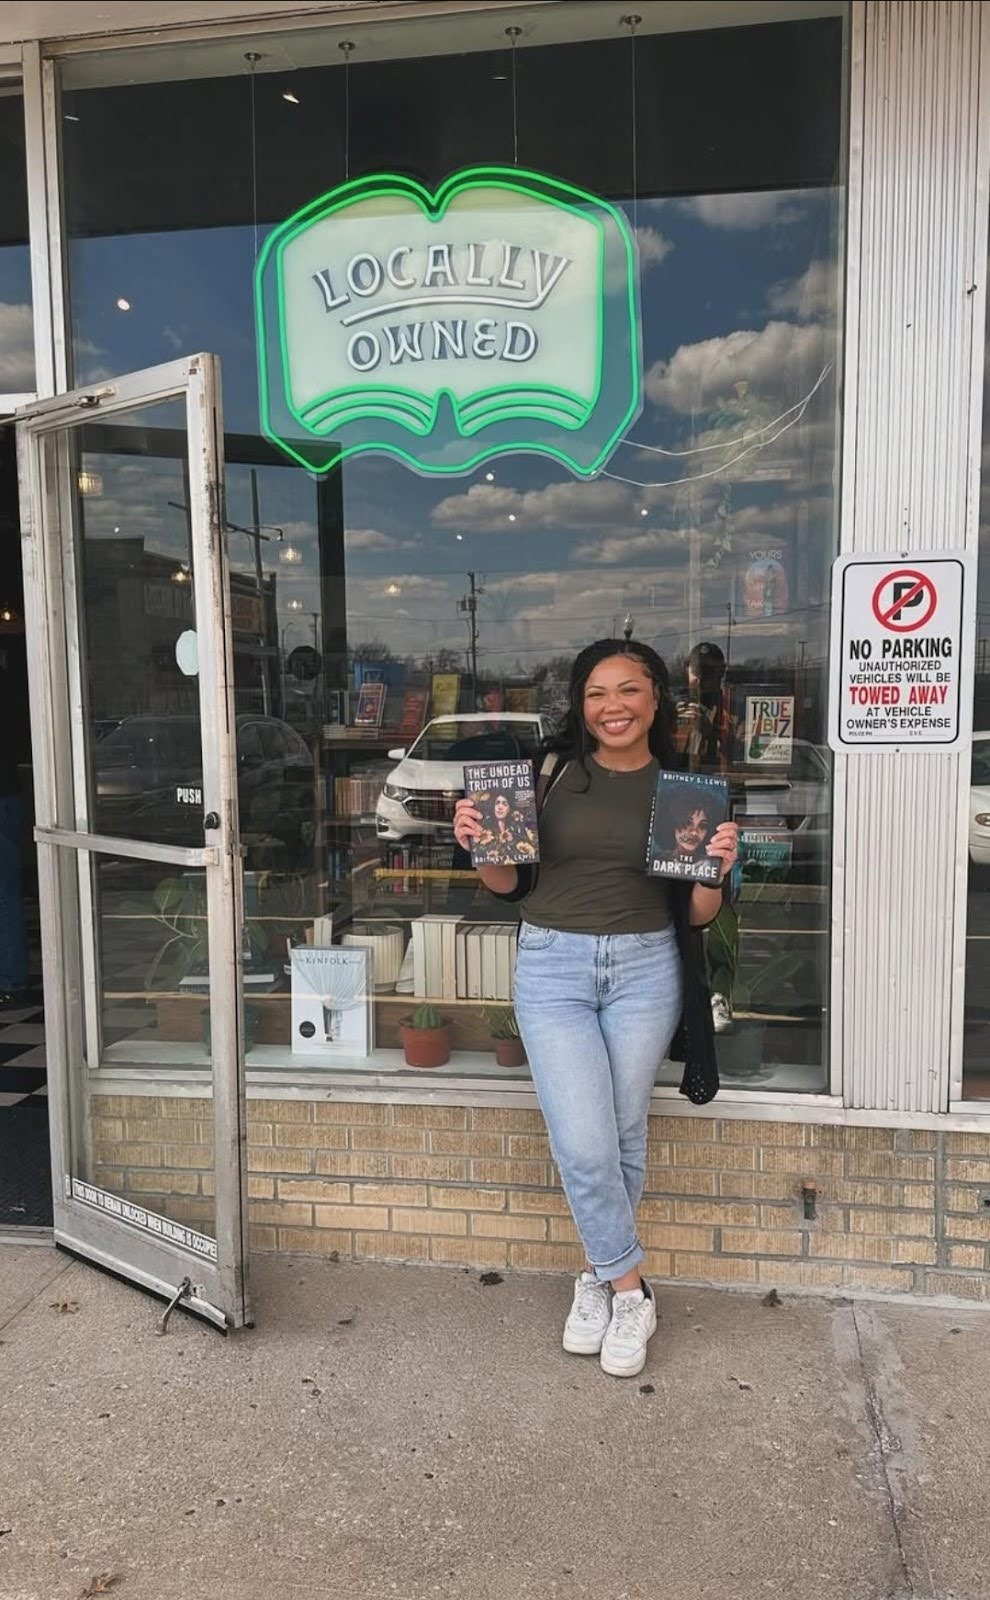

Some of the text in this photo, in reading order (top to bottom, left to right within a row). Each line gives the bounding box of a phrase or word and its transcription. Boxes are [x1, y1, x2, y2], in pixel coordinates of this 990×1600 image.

[313, 242, 572, 314] LOCALLY
[347, 319, 538, 371] OWNED
[749, 550, 783, 560] YOURS
[850, 637, 952, 660] NO PARKING
[859, 660, 942, 672] UNAUTHORIZED
[849, 672, 951, 684] VEHICLES WILL BE
[849, 685, 948, 705] TOWED AWAY
[751, 701, 791, 720] TRUE
[866, 706, 932, 718] AT VEHICLE
[764, 718, 791, 738] BIZ
[847, 718, 951, 729] OWNER'S EXPENSE
[468, 764, 529, 780] THE UNDEAD
[663, 773, 695, 783] BRITNEY
[705, 778, 727, 787] LEWIS
[469, 776, 530, 792] TRUTH OF US
[177, 788, 202, 804] PUSH
[679, 855, 694, 863] THE
[653, 860, 718, 878] DARK PLACE
[306, 957, 349, 965] KINFOLK
